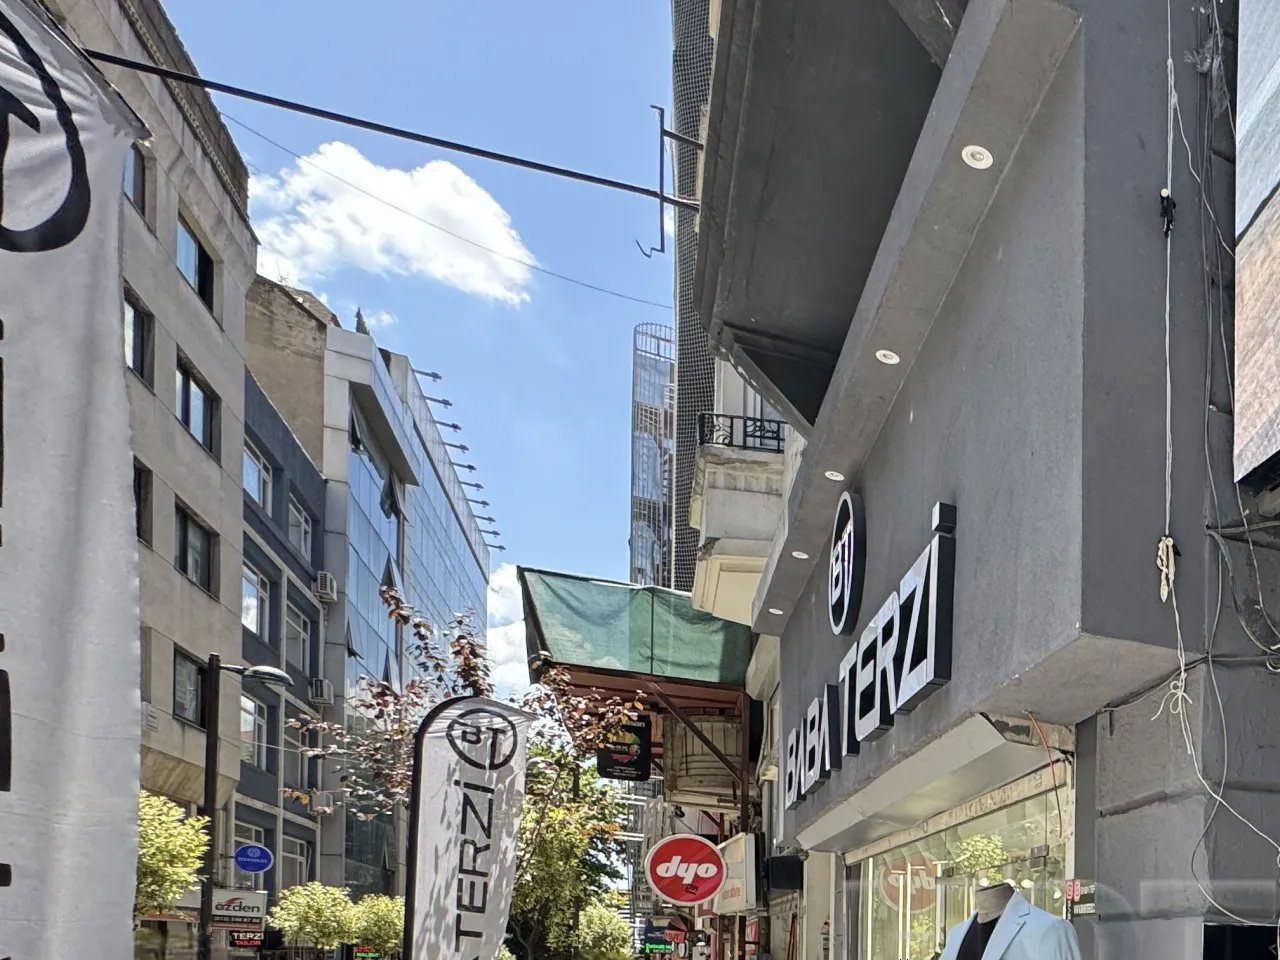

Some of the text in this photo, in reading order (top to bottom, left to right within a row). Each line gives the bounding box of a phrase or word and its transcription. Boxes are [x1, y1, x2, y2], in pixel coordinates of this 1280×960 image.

[839, 501, 956, 757] TERZİ
[215, 902, 260, 913] özden
[453, 778, 496, 953] TERZİ
[655, 855, 718, 884] dyo
